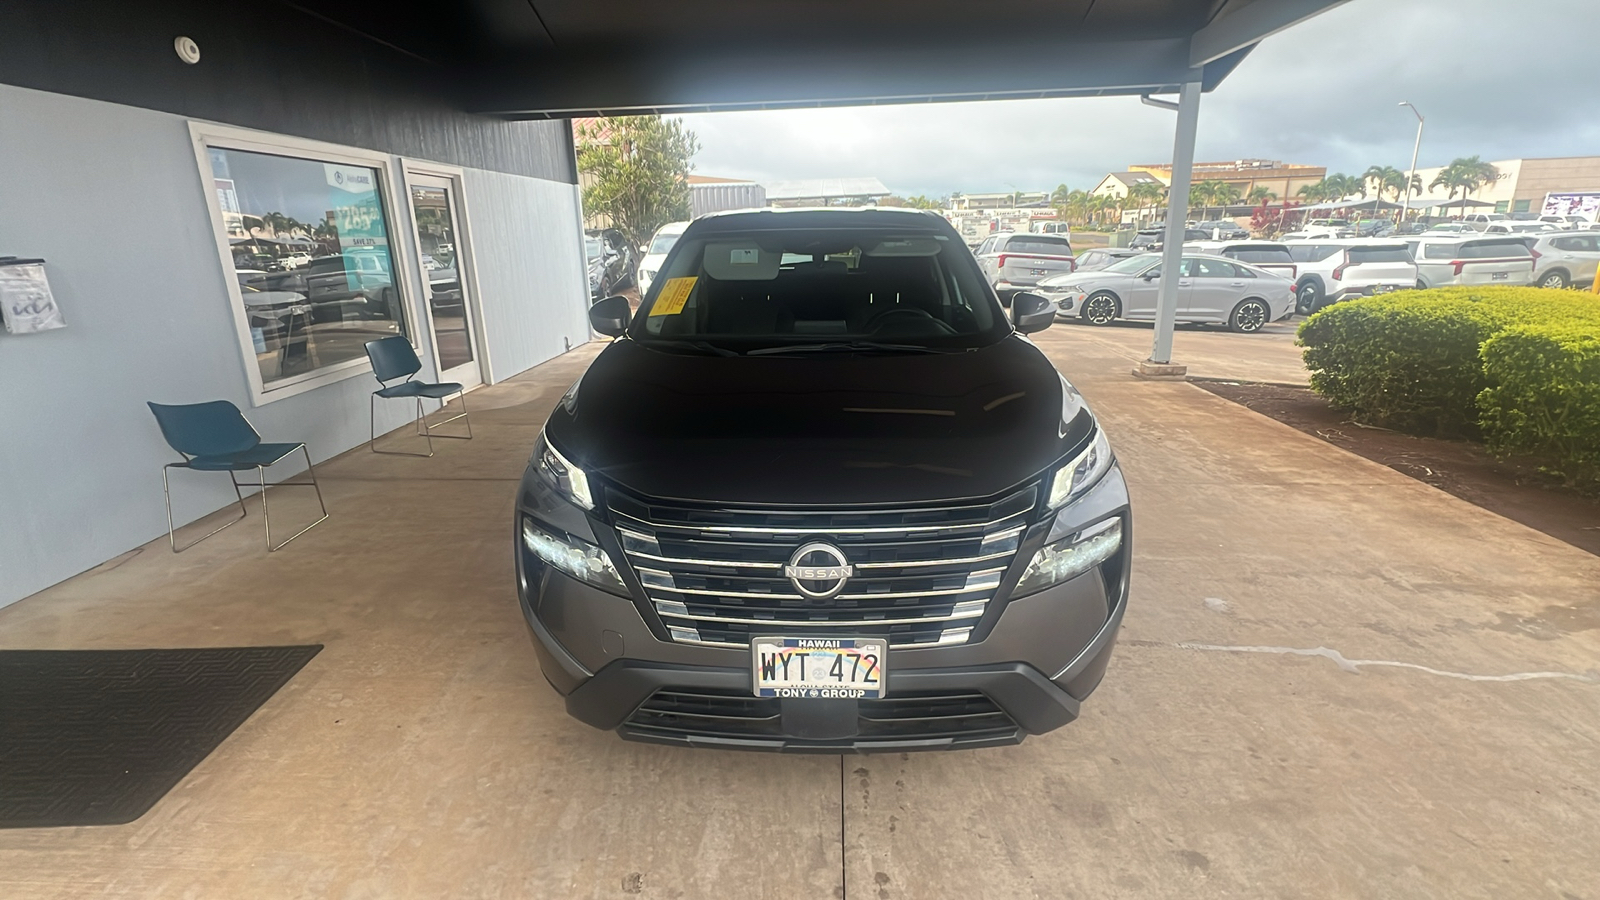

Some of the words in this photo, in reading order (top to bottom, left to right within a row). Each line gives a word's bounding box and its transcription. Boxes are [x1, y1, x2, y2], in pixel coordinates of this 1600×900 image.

[786, 567, 851, 578] NISSAN
[798, 640, 840, 648] HAWAII
[761, 652, 810, 681] WYT
[829, 653, 878, 683] 472
[774, 689, 807, 697] TONY
[821, 689, 865, 698] GROUP
